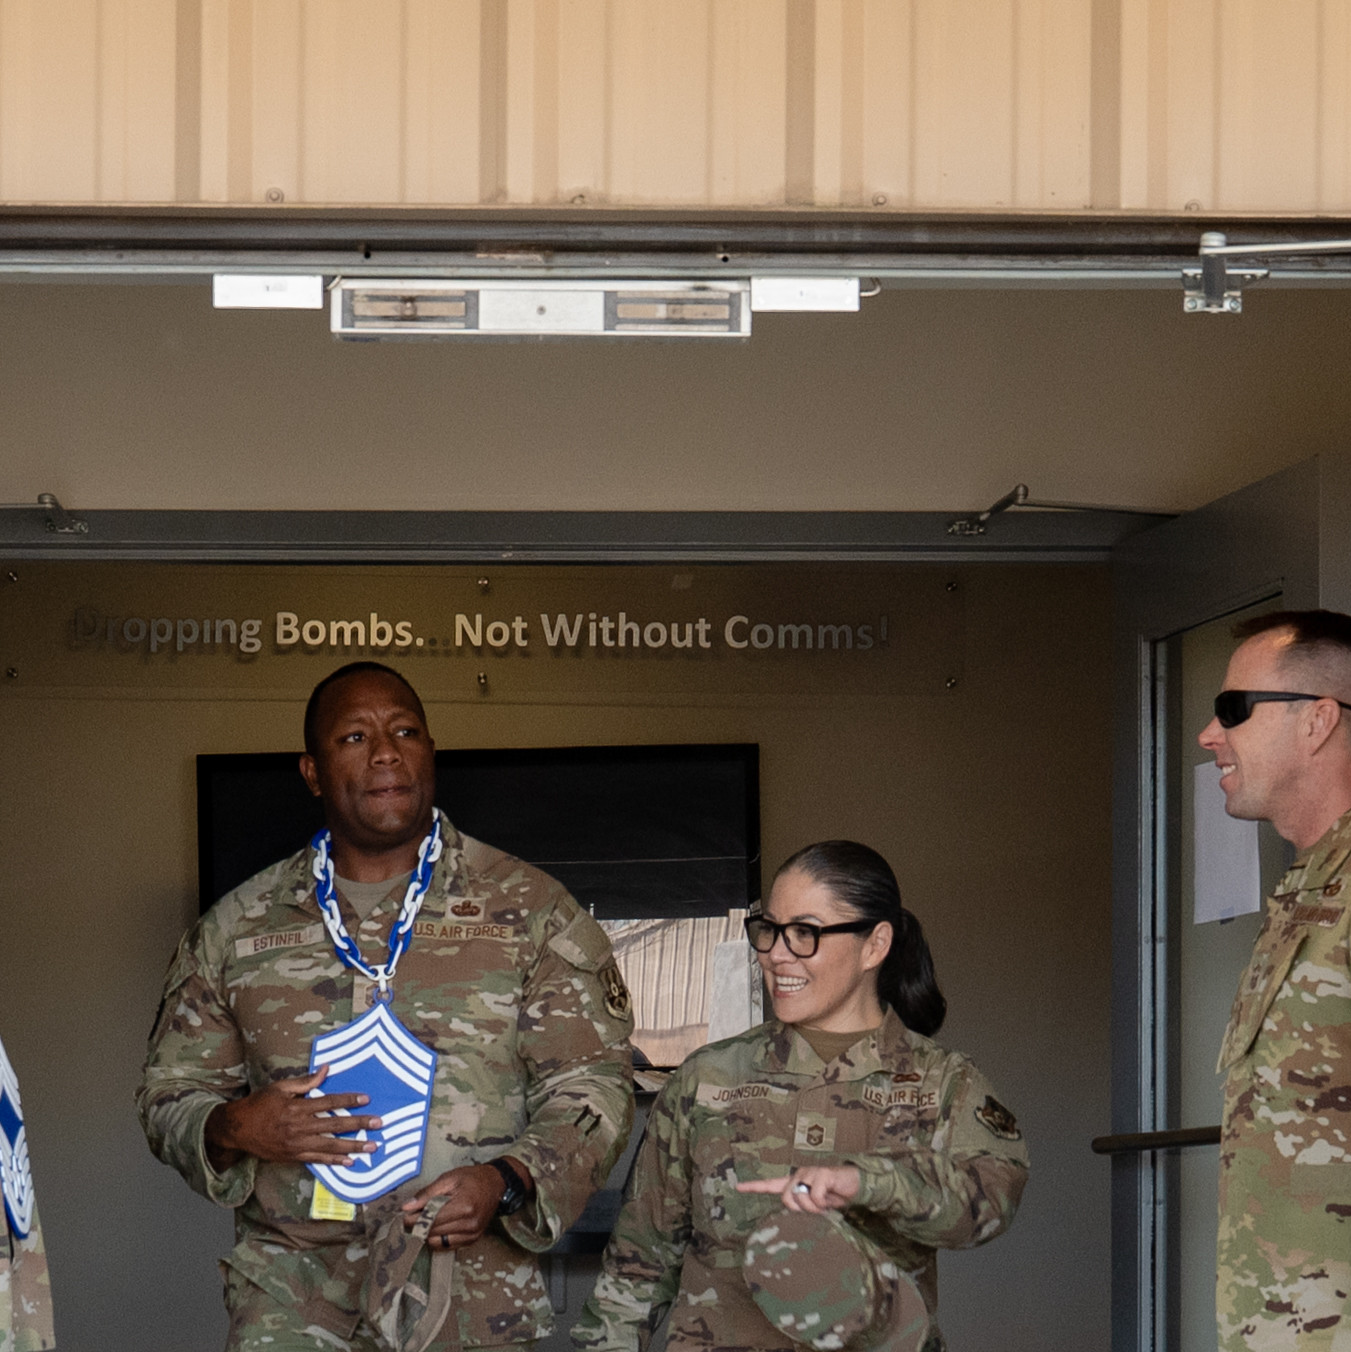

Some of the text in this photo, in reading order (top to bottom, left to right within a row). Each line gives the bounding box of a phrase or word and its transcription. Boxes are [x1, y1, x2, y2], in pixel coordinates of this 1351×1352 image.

[73, 608, 263, 654] Dropping
[454, 613, 528, 648] Not
[540, 610, 711, 649] Without
[724, 613, 891, 650] Comms!
[414, 923, 508, 939] U.S. AIR FORCE
[253, 932, 304, 952] ESTINFIL
[711, 1085, 770, 1103] JOHNSON
[863, 1086, 884, 1107] U.S.
[886, 1090, 907, 1105] AIR
